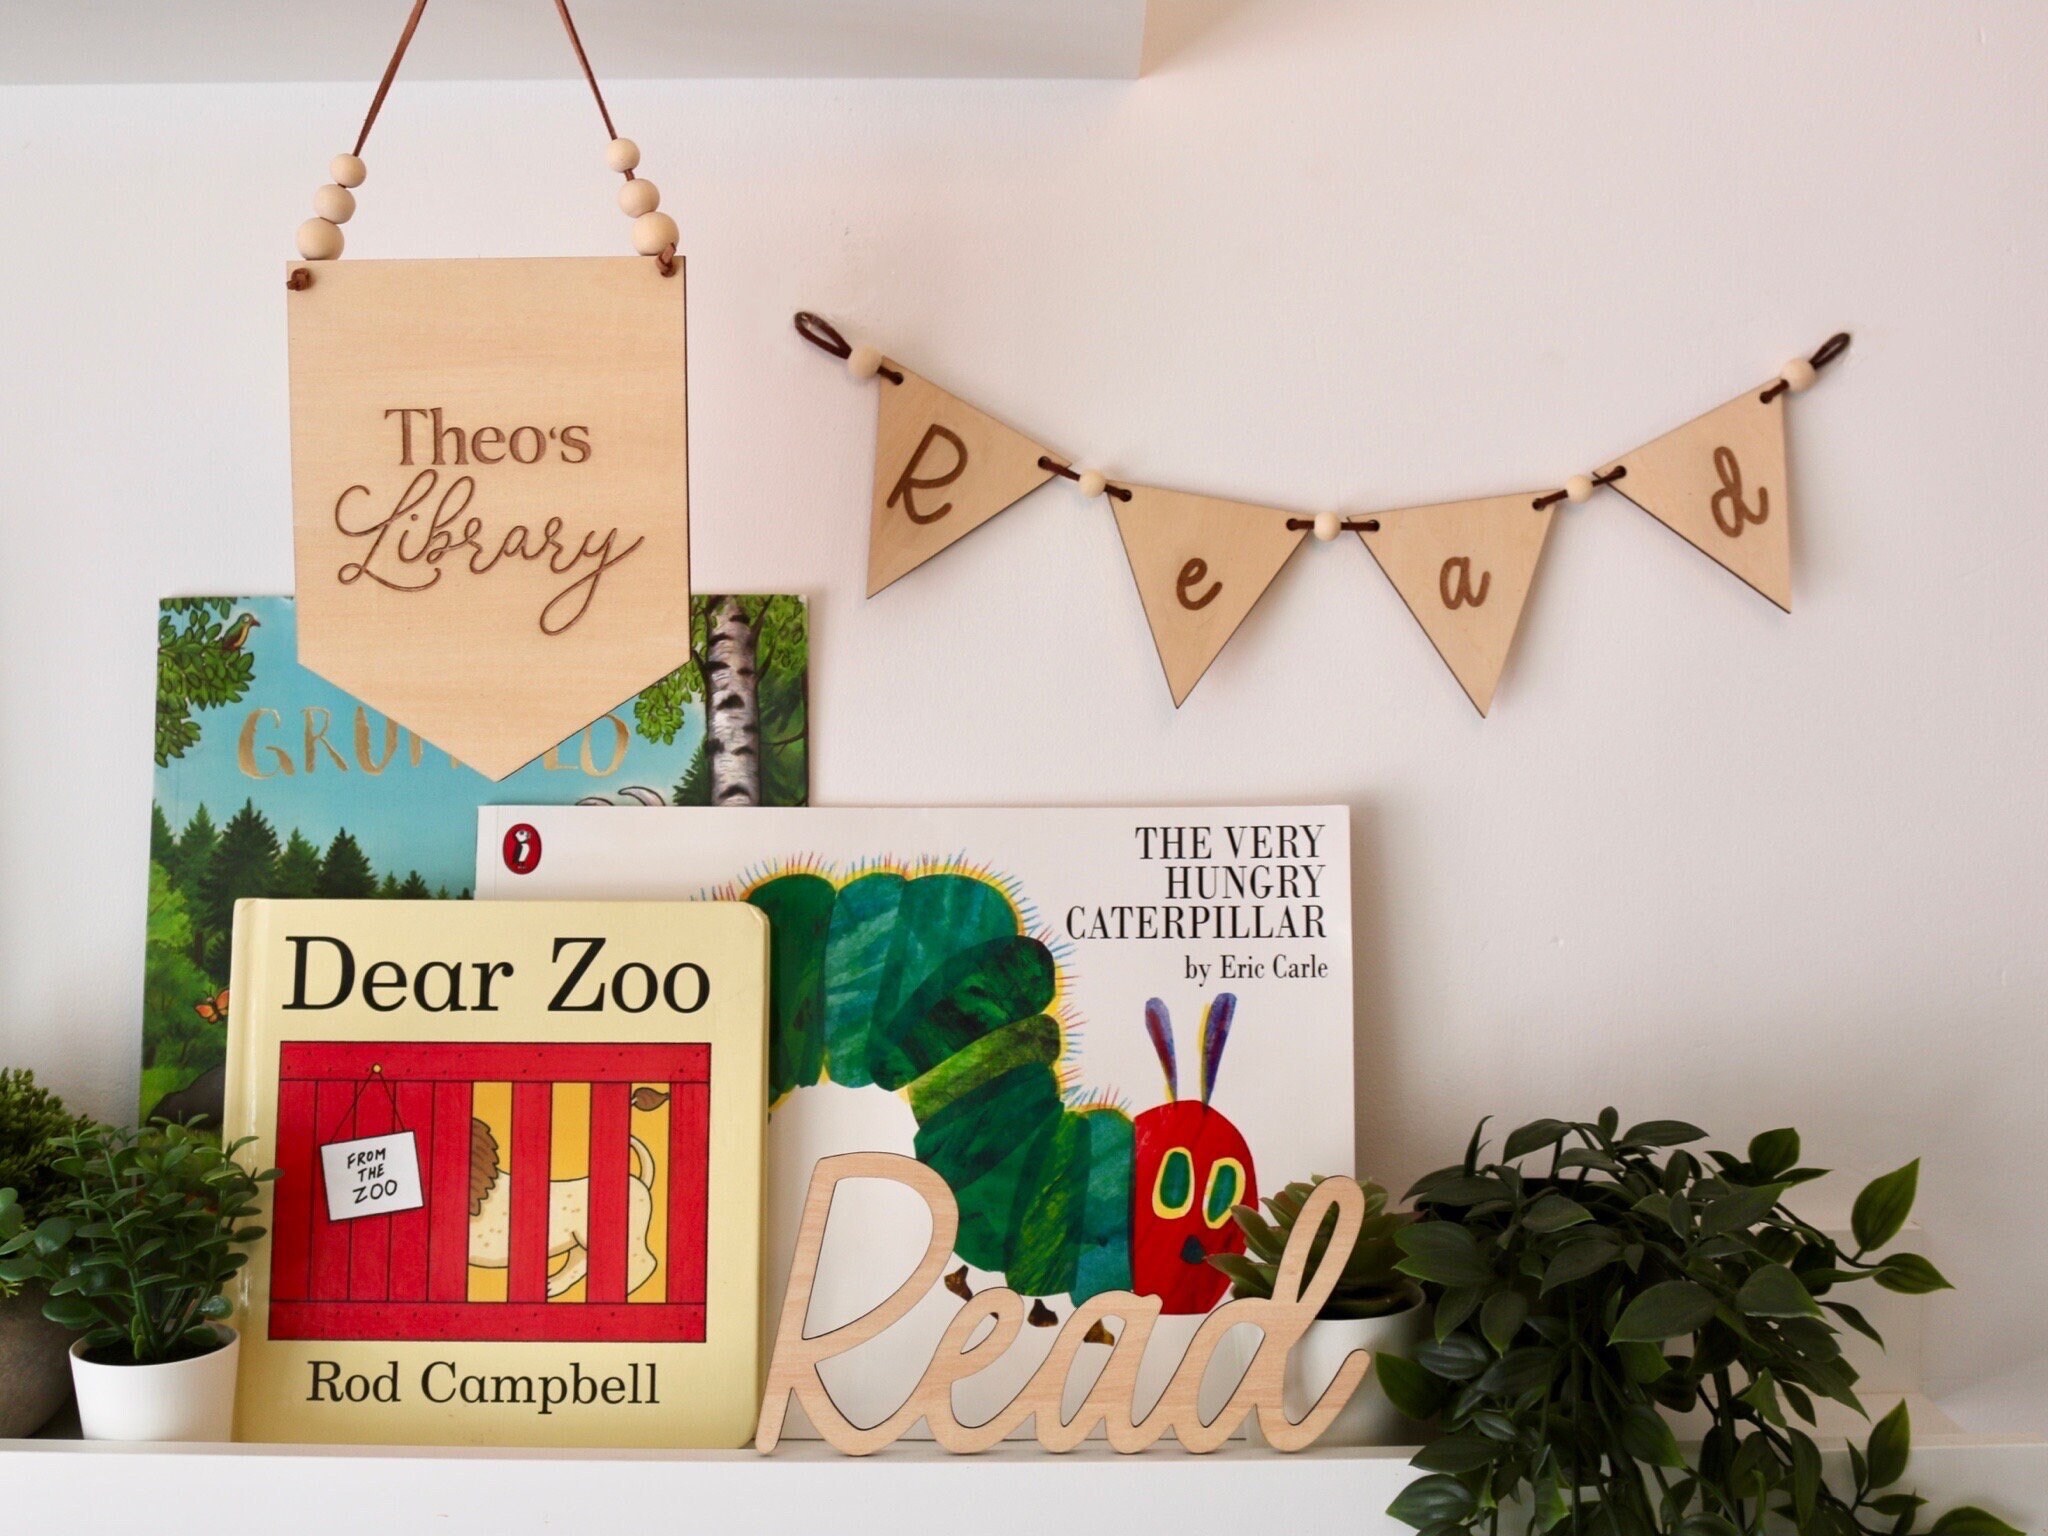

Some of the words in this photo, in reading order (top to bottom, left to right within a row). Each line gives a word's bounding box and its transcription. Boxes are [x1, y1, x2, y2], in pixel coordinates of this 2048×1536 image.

[384, 407, 592, 465] Theo's
[335, 468, 645, 636] Library
[238, 705, 630, 780] GRULO
[1135, 826, 1212, 859] THE
[1224, 825, 1326, 858] VERY
[1165, 865, 1326, 899] HUNGRY
[1066, 905, 1327, 939] CATERPILLAR
[281, 935, 514, 1013] Dear
[547, 937, 711, 1014] Zoo
[1185, 955, 1211, 987] by
[1219, 955, 1265, 979] Eric
[1273, 954, 1328, 978] Carle
[347, 1147, 386, 1169] FROM
[358, 1163, 385, 1182] THE
[352, 1179, 398, 1204] ZOO
[755, 1151, 1371, 1456] Read
[306, 1360, 401, 1403] Rod
[420, 1362, 660, 1415] Campbell
